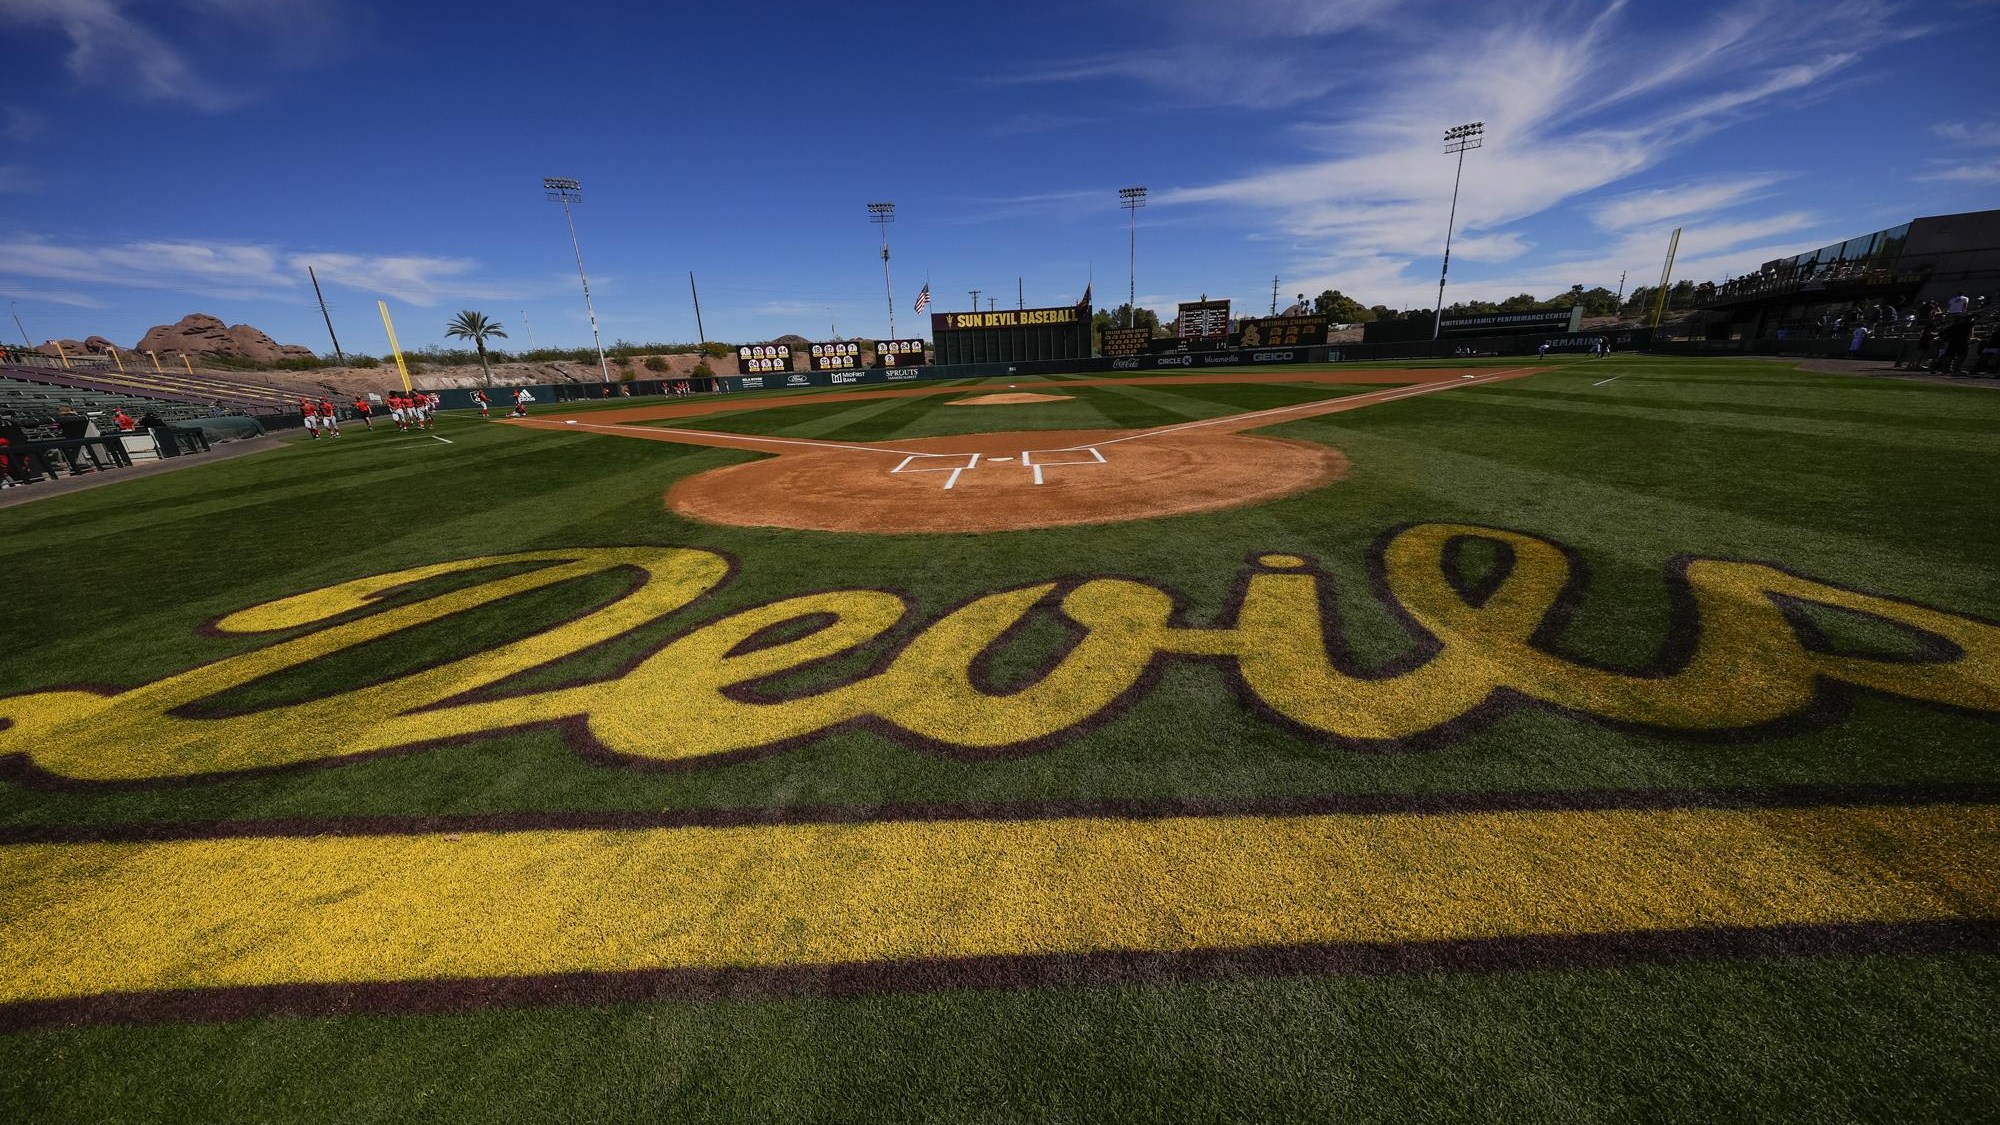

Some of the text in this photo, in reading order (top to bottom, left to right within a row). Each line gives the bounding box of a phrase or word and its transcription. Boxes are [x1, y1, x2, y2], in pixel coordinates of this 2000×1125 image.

[957, 309, 1078, 328] SUN DEVIL BASEBALL
[1497, 314, 1544, 322] PERFORMANCE
[1545, 312, 1572, 320] CENTER
[1545, 338, 1600, 346] DEMARIN
[1204, 355, 1238, 364] bluemedia
[1252, 352, 1294, 362] GEICO
[1158, 358, 1182, 366] CIRCLE
[886, 368, 918, 377] SPROUTS
